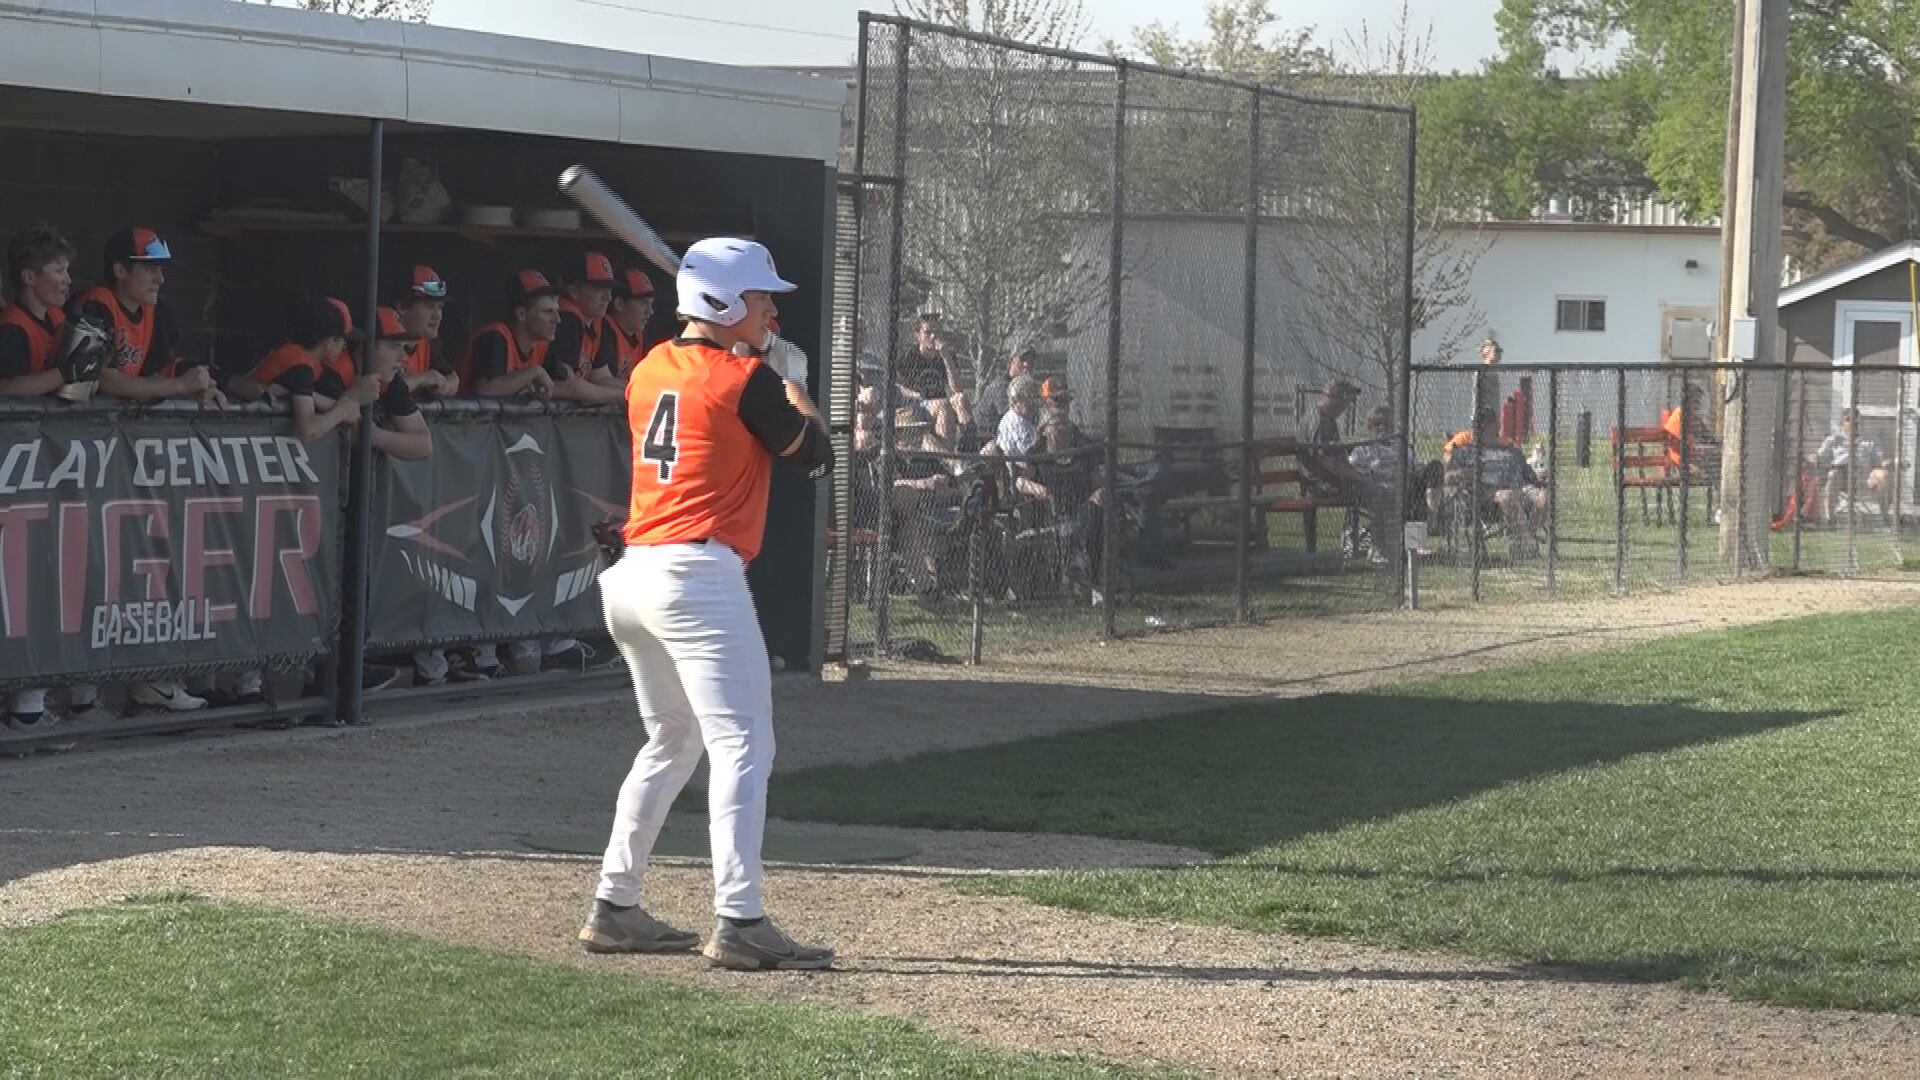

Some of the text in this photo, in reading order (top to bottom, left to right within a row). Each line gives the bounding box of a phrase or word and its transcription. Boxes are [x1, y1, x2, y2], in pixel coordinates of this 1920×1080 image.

[0, 436, 320, 494] CLAY CENTER
[641, 391, 680, 484] 4
[0, 495, 321, 638] TIGER
[91, 598, 217, 649] BASEBALL
